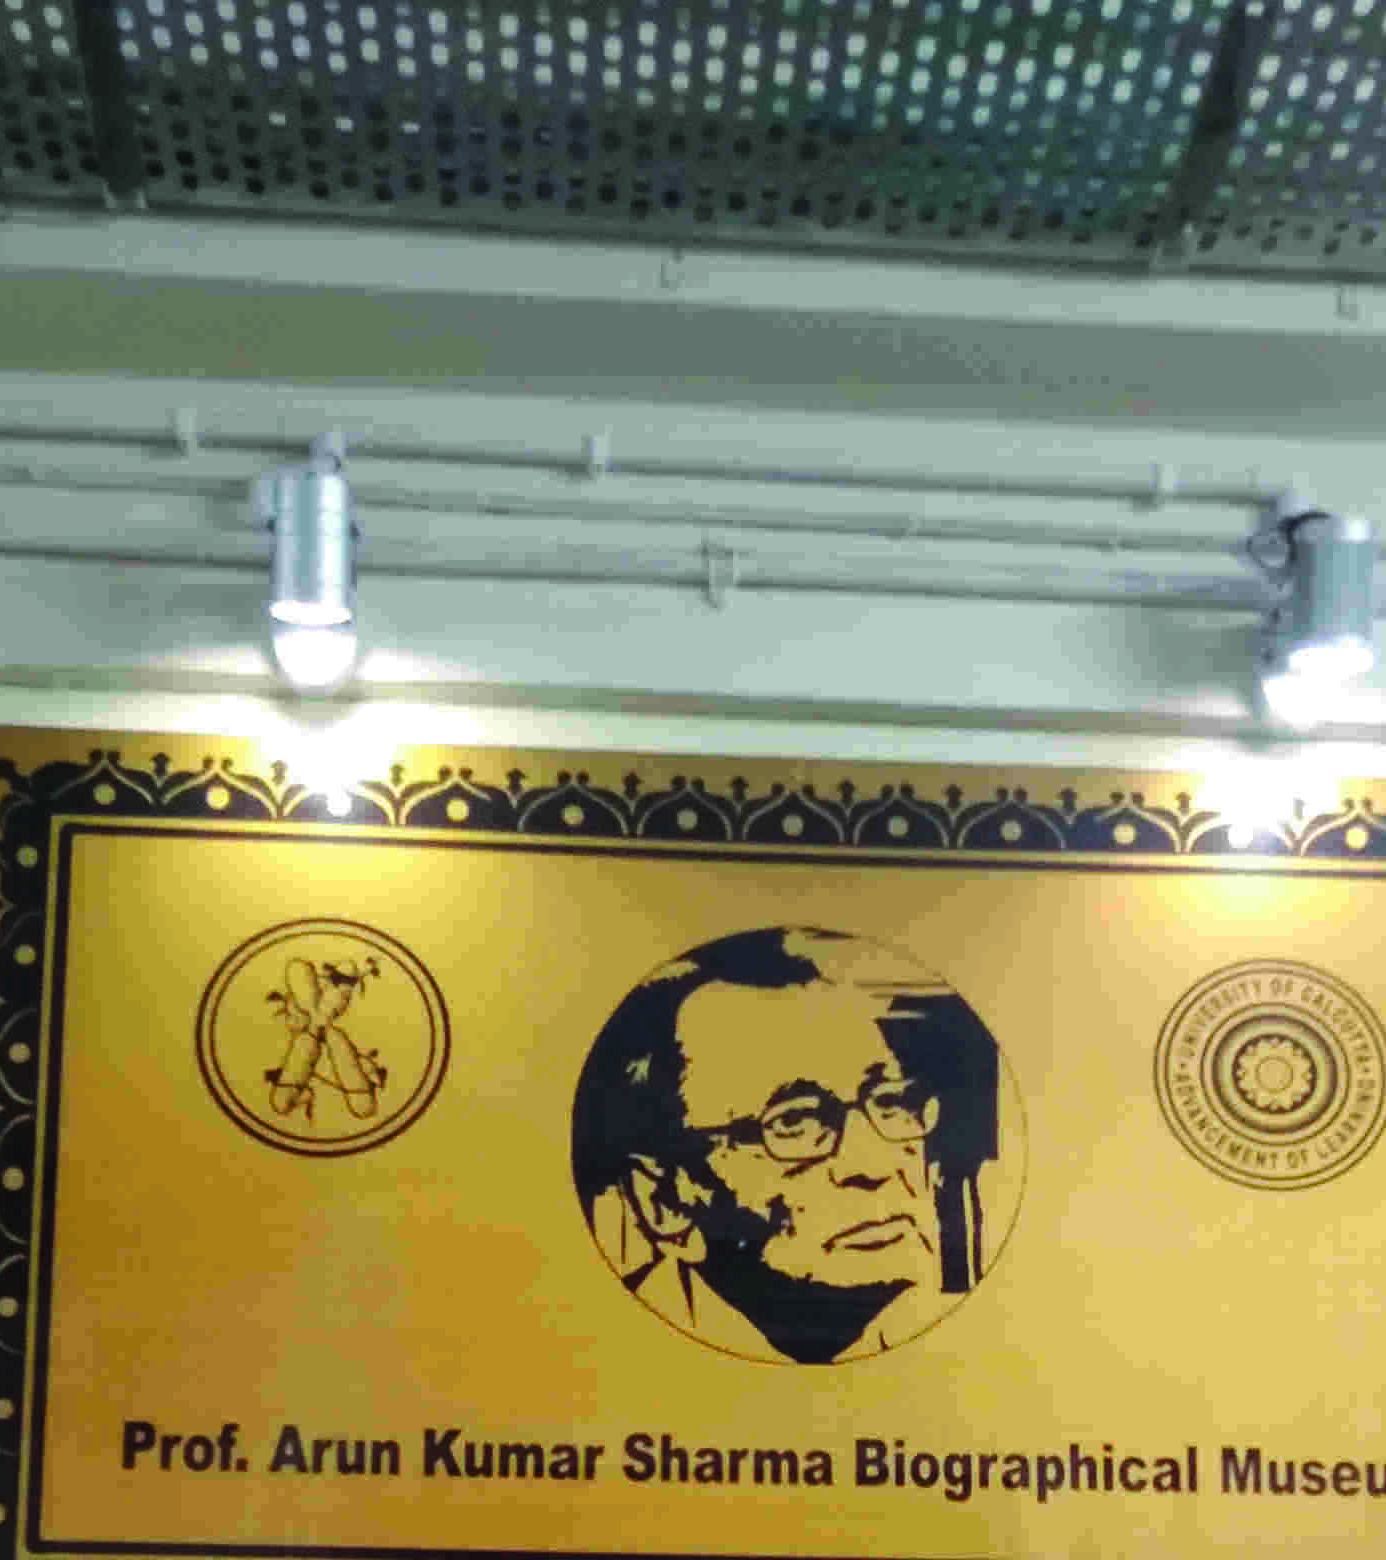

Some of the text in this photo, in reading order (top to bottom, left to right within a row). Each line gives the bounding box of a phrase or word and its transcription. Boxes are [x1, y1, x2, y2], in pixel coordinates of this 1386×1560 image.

[1269, 977, 1295, 997] OF
[1285, 1148, 1310, 1170] OF
[120, 1420, 250, 1473] Prof.
[268, 1424, 401, 1476] Arun
[421, 1427, 606, 1481] Kumar
[621, 1432, 834, 1487] Sharma
[853, 1437, 1199, 1505] Biographical
